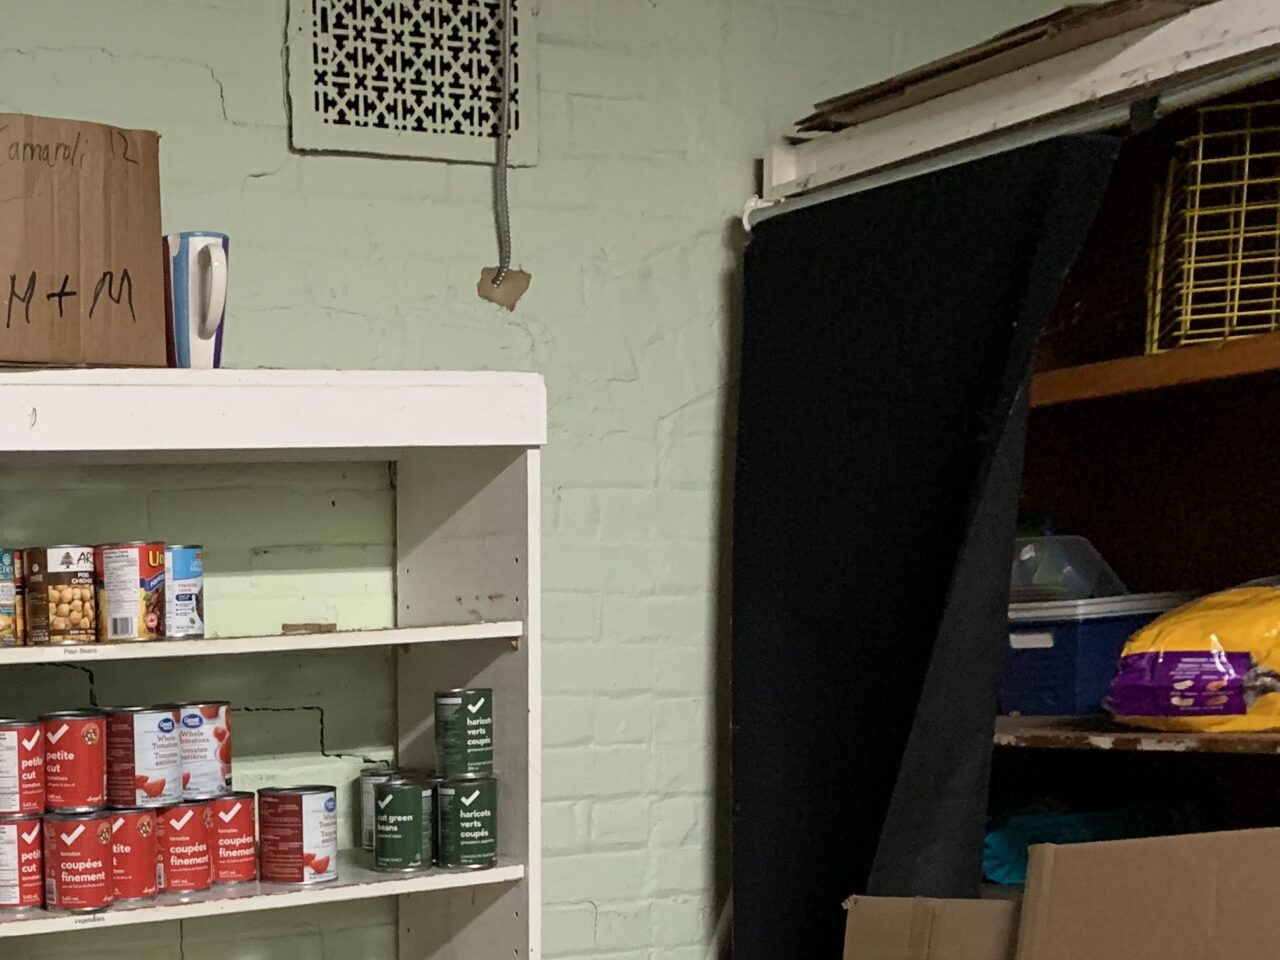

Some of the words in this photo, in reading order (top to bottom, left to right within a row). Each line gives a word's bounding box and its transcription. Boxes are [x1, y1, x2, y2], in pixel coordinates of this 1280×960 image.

[6, 271, 36, 329] M
[89, 268, 136, 323] M
[46, 751, 75, 763] petite
[46, 763, 61, 773] cut
[22, 770, 36, 780] cut
[389, 814, 413, 823] green
[460, 809, 491, 818] haricots
[460, 820, 482, 828] verts
[460, 828, 489, 839] coupés
[218, 834, 253, 847] coupées
[112, 843, 131, 853] tite
[170, 842, 207, 856] coupées
[21, 850, 41, 862] petit
[170, 854, 209, 866] finement
[22, 863, 36, 873] cut
[61, 858, 102, 872] coupées
[61, 871, 105, 882] finement
[74, 915, 106, 925] Vegetables
